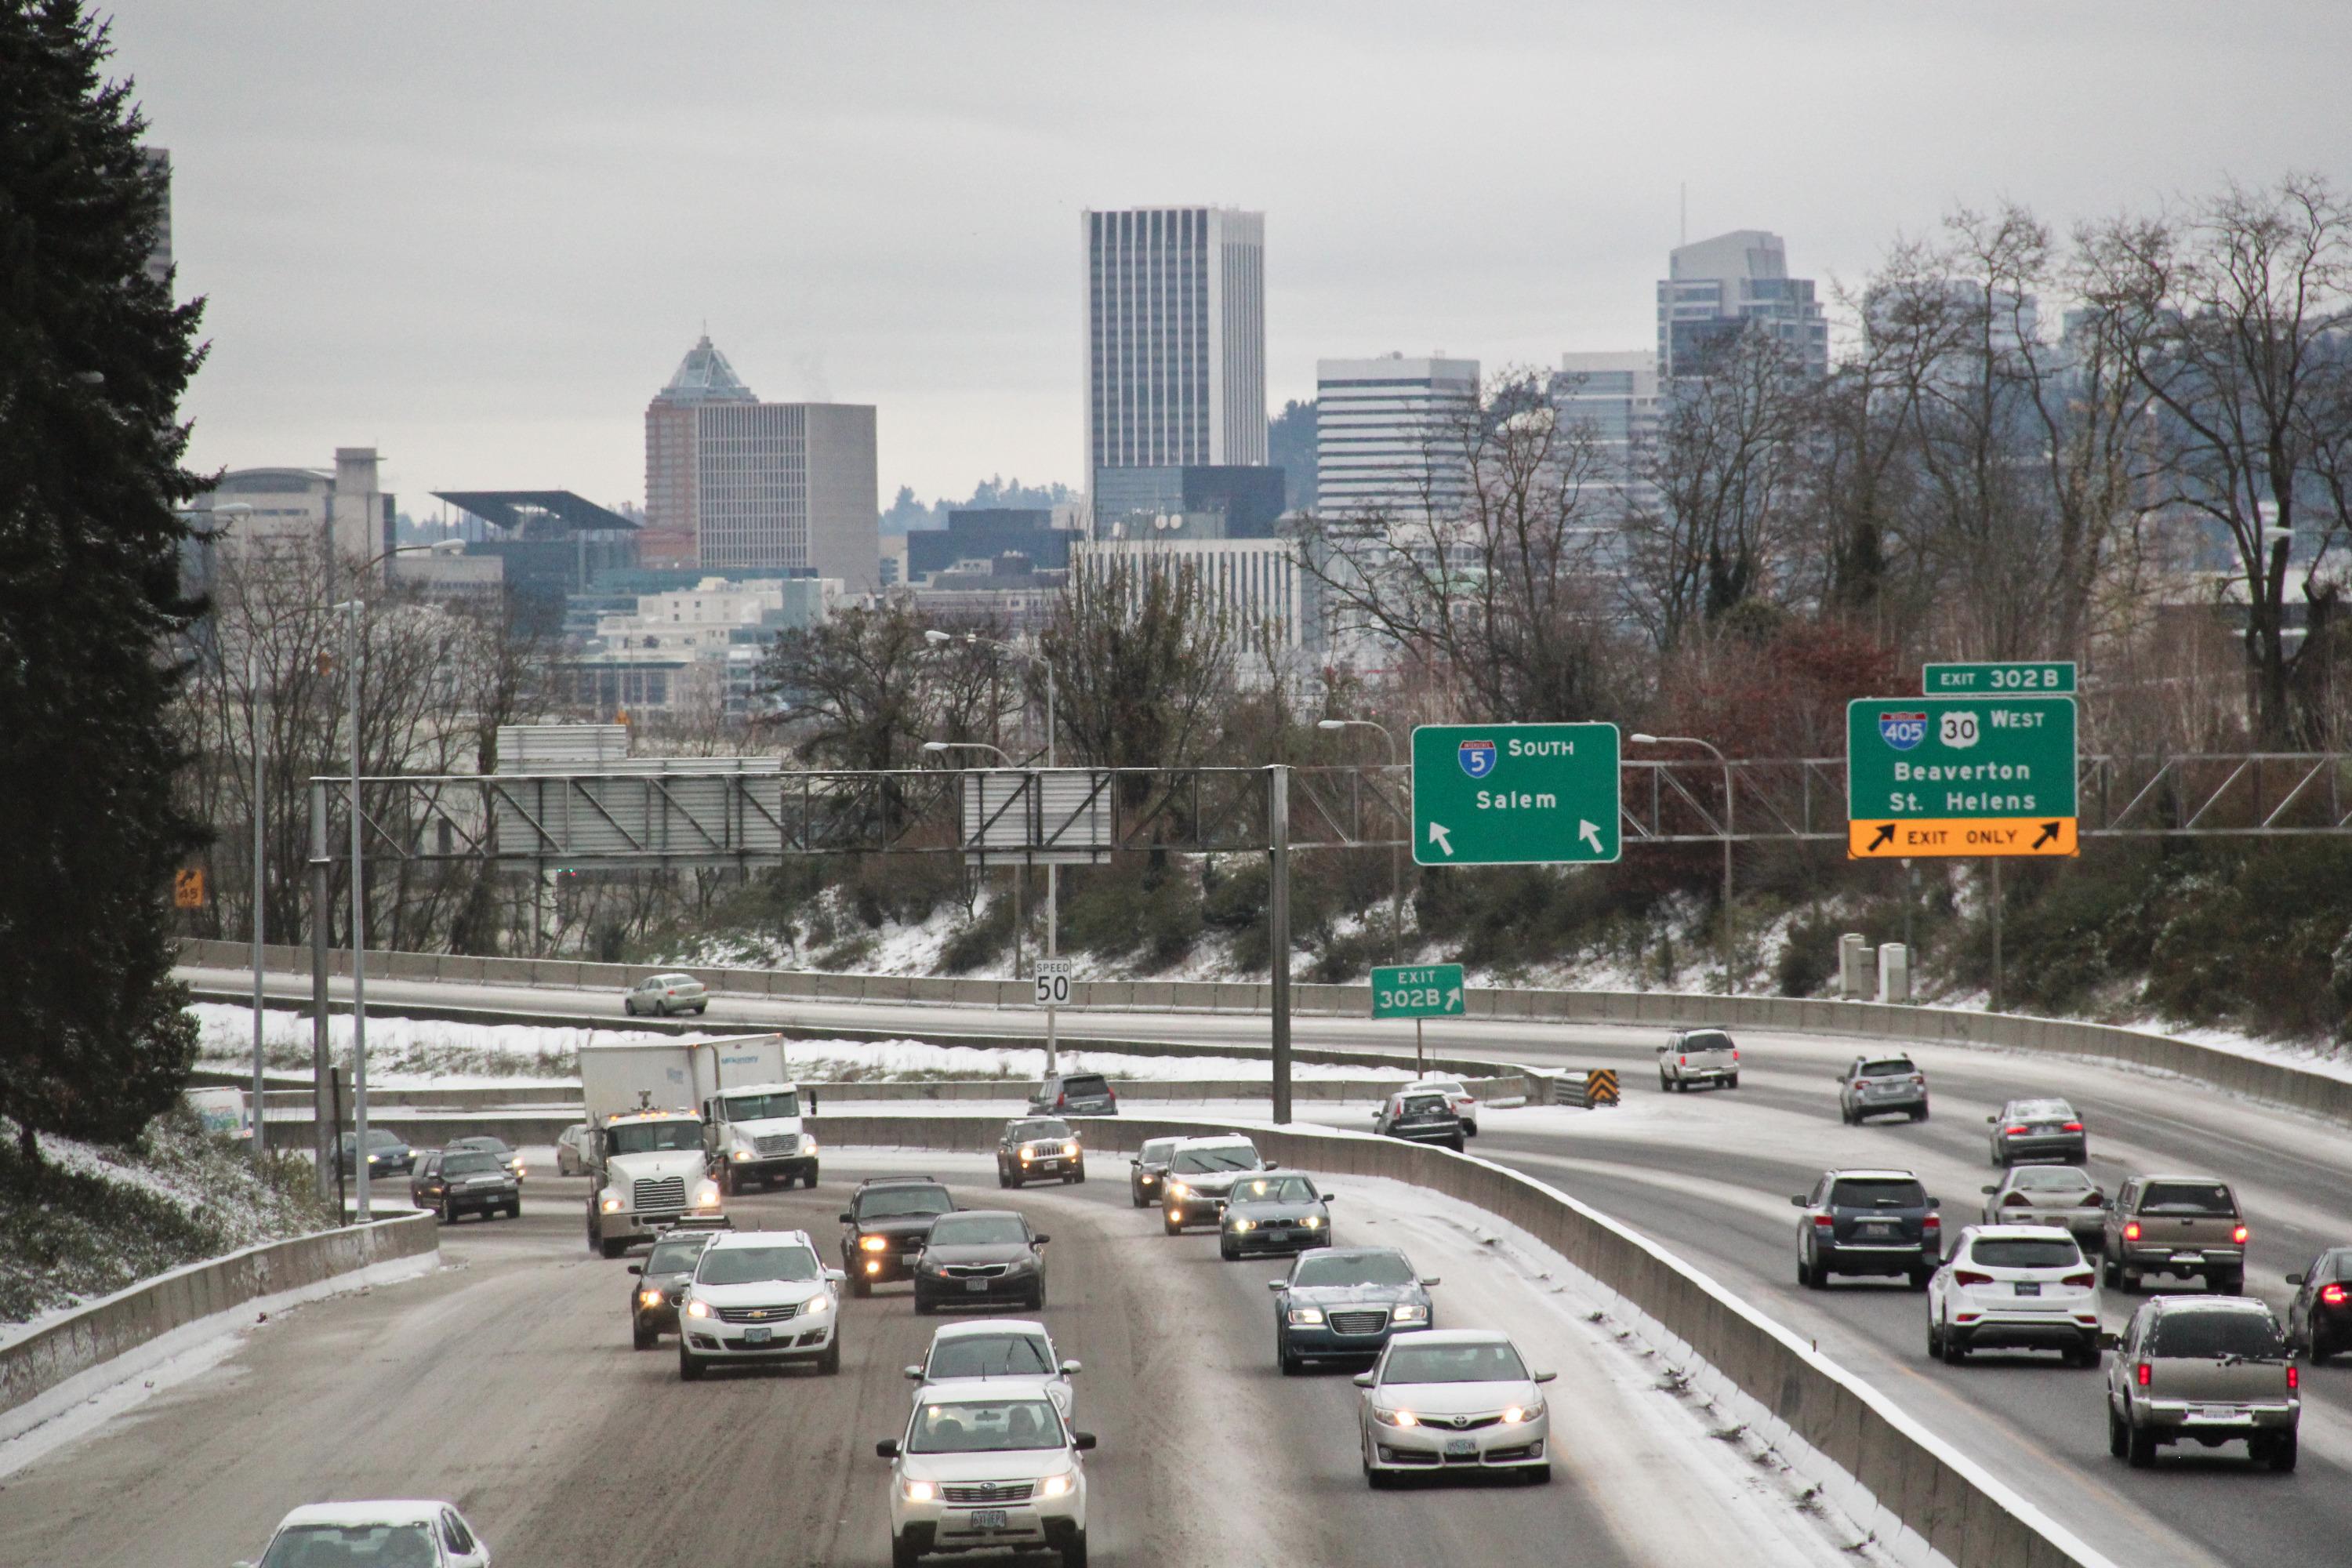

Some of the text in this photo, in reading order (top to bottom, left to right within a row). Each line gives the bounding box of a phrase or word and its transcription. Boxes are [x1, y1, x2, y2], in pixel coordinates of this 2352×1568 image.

[1940, 673, 1976, 686] EXIT
[1990, 710, 2045, 728] WEST
[1883, 723, 1922, 742] 405
[1944, 719, 1976, 740] 30
[1508, 739, 1574, 757] SOUTH
[1471, 751, 1486, 772] 5
[1894, 760, 2031, 781] Beaverton
[1476, 790, 1557, 809] Salem
[1889, 792, 2036, 811] St. Helens
[1907, 829, 2018, 844] EXIT ONLY
[1036, 963, 1069, 973] SPEED
[1398, 970, 1436, 984] EXIT
[1037, 975, 1069, 1001] 50
[1379, 988, 1440, 1008] 302B
